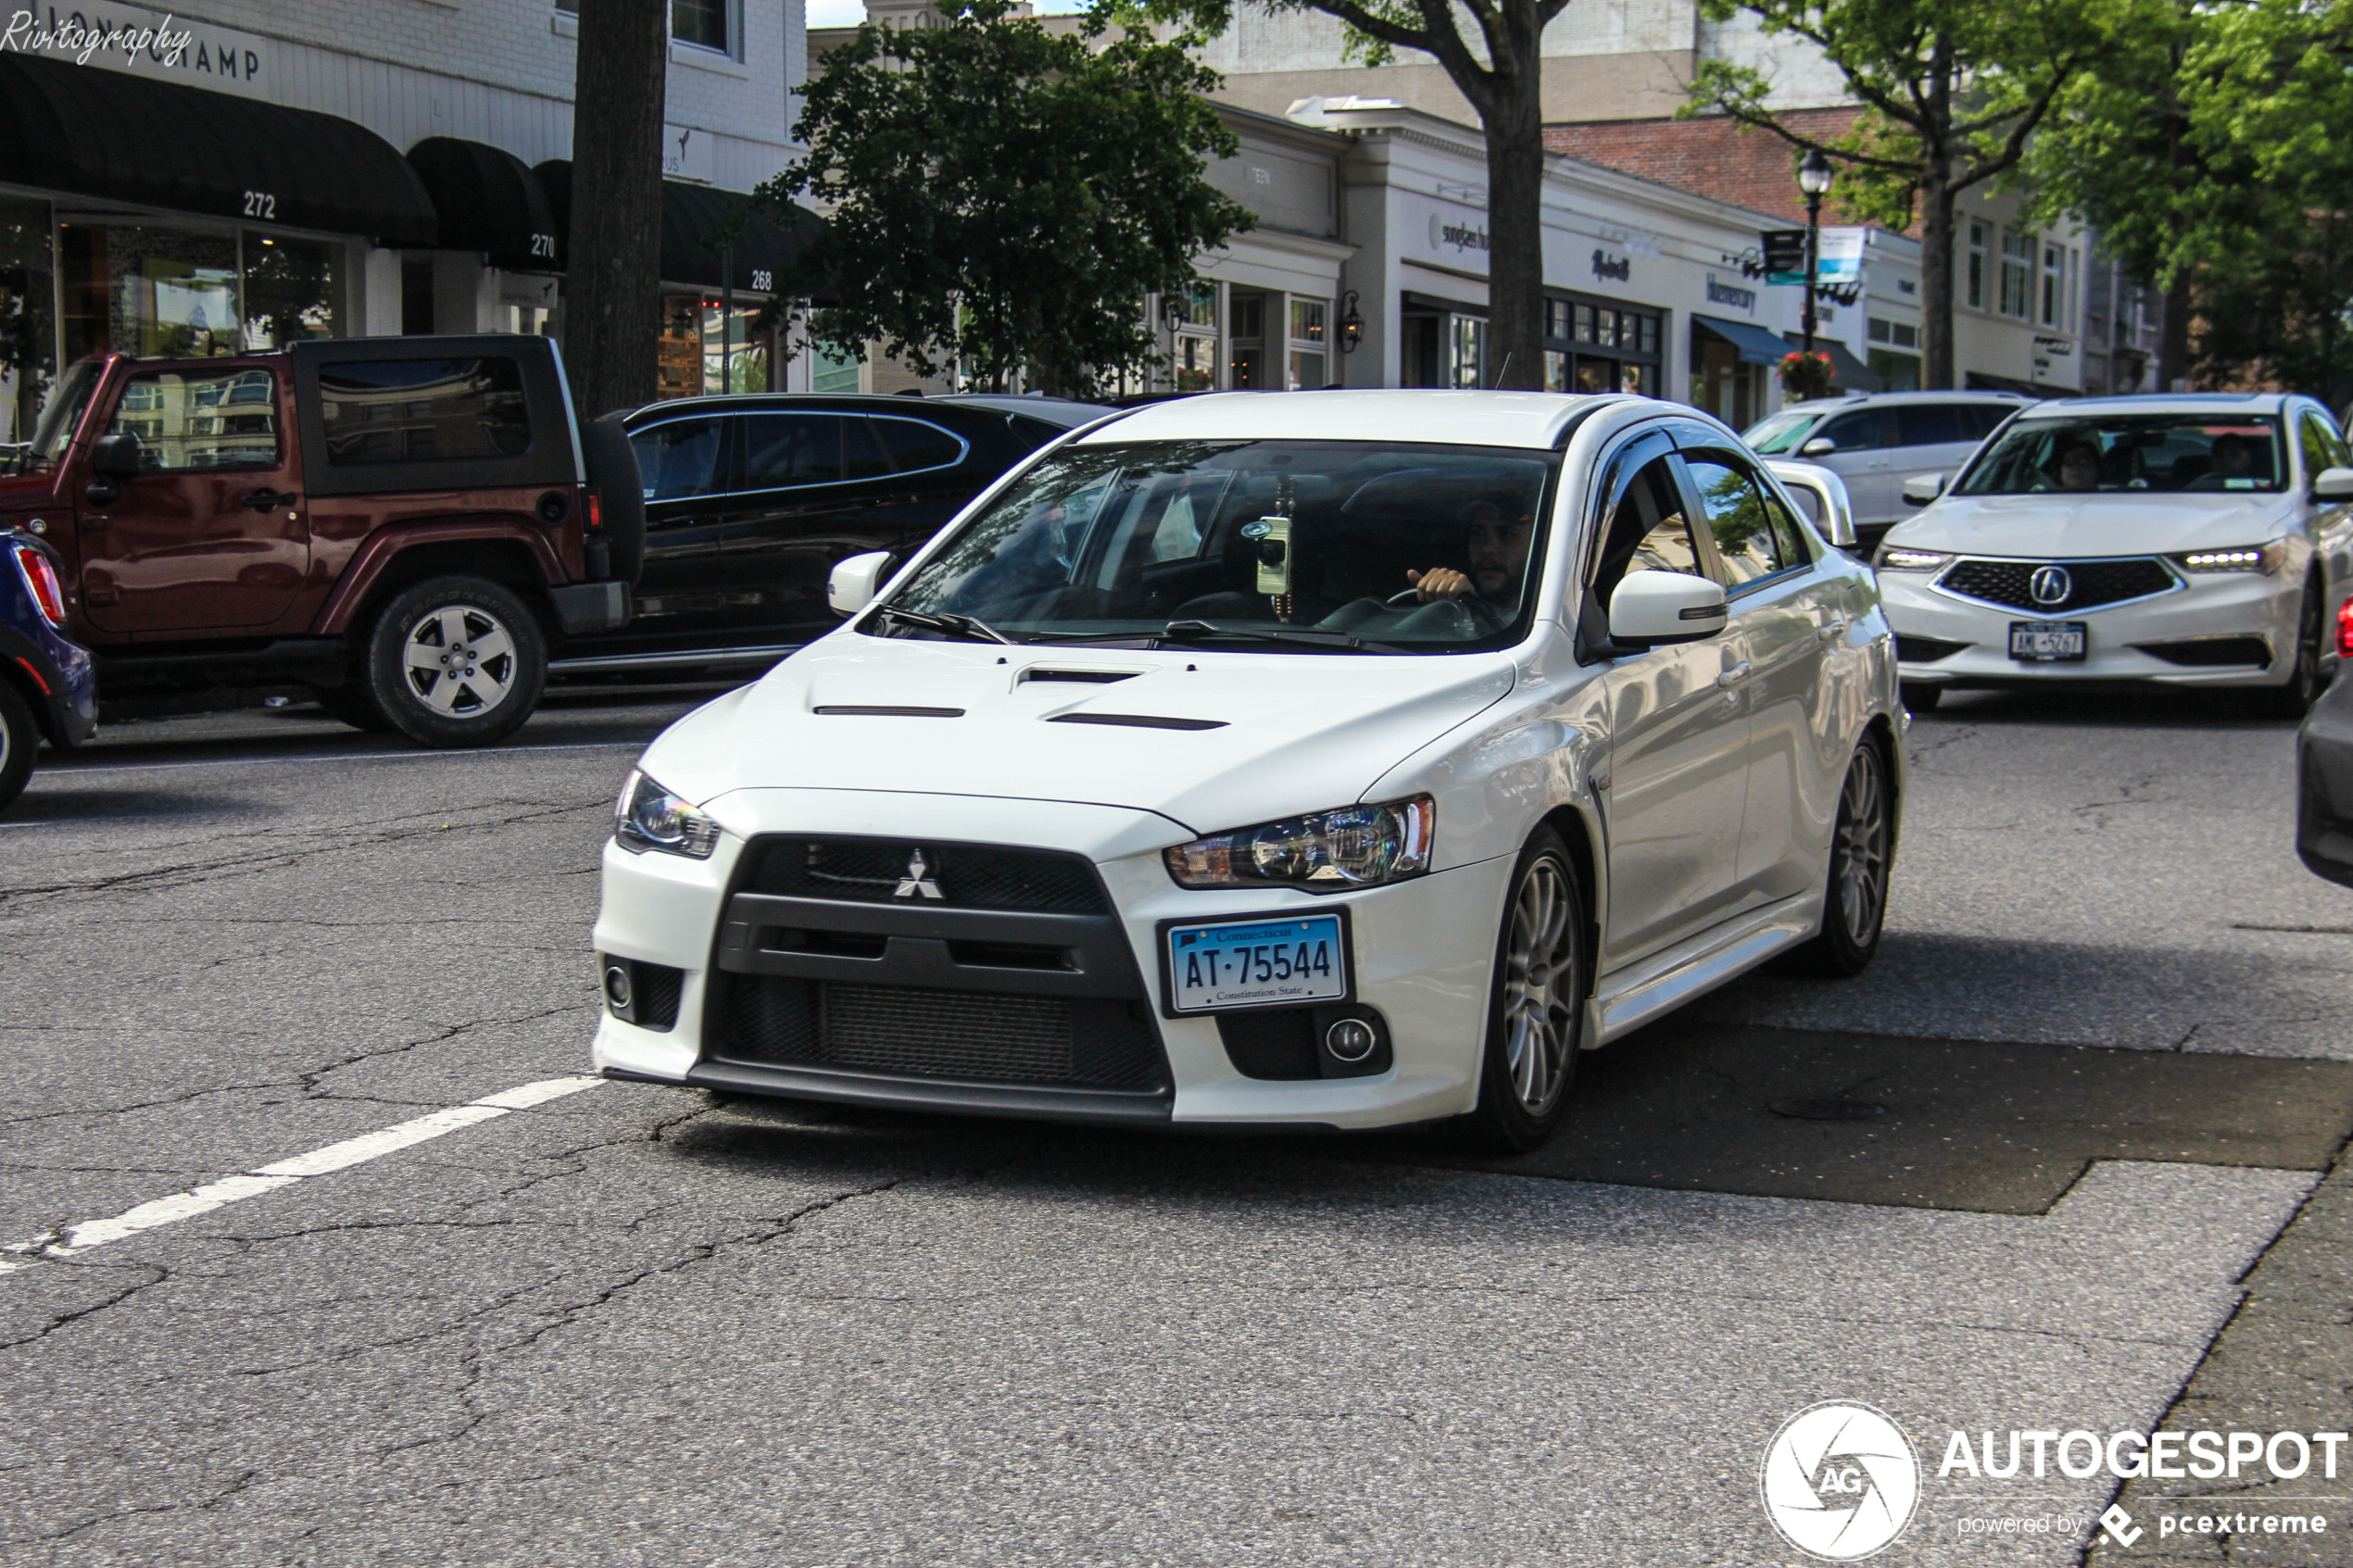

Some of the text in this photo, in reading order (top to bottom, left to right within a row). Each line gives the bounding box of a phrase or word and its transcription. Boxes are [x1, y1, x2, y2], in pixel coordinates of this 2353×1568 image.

[245, 191, 275, 219] 272
[531, 233, 555, 258] 270
[1442, 221, 1477, 253] sunglass
[752, 270, 772, 291] 268
[1216, 927, 1292, 943] Connecticut
[1216, 985, 1302, 1001] Constitution State
